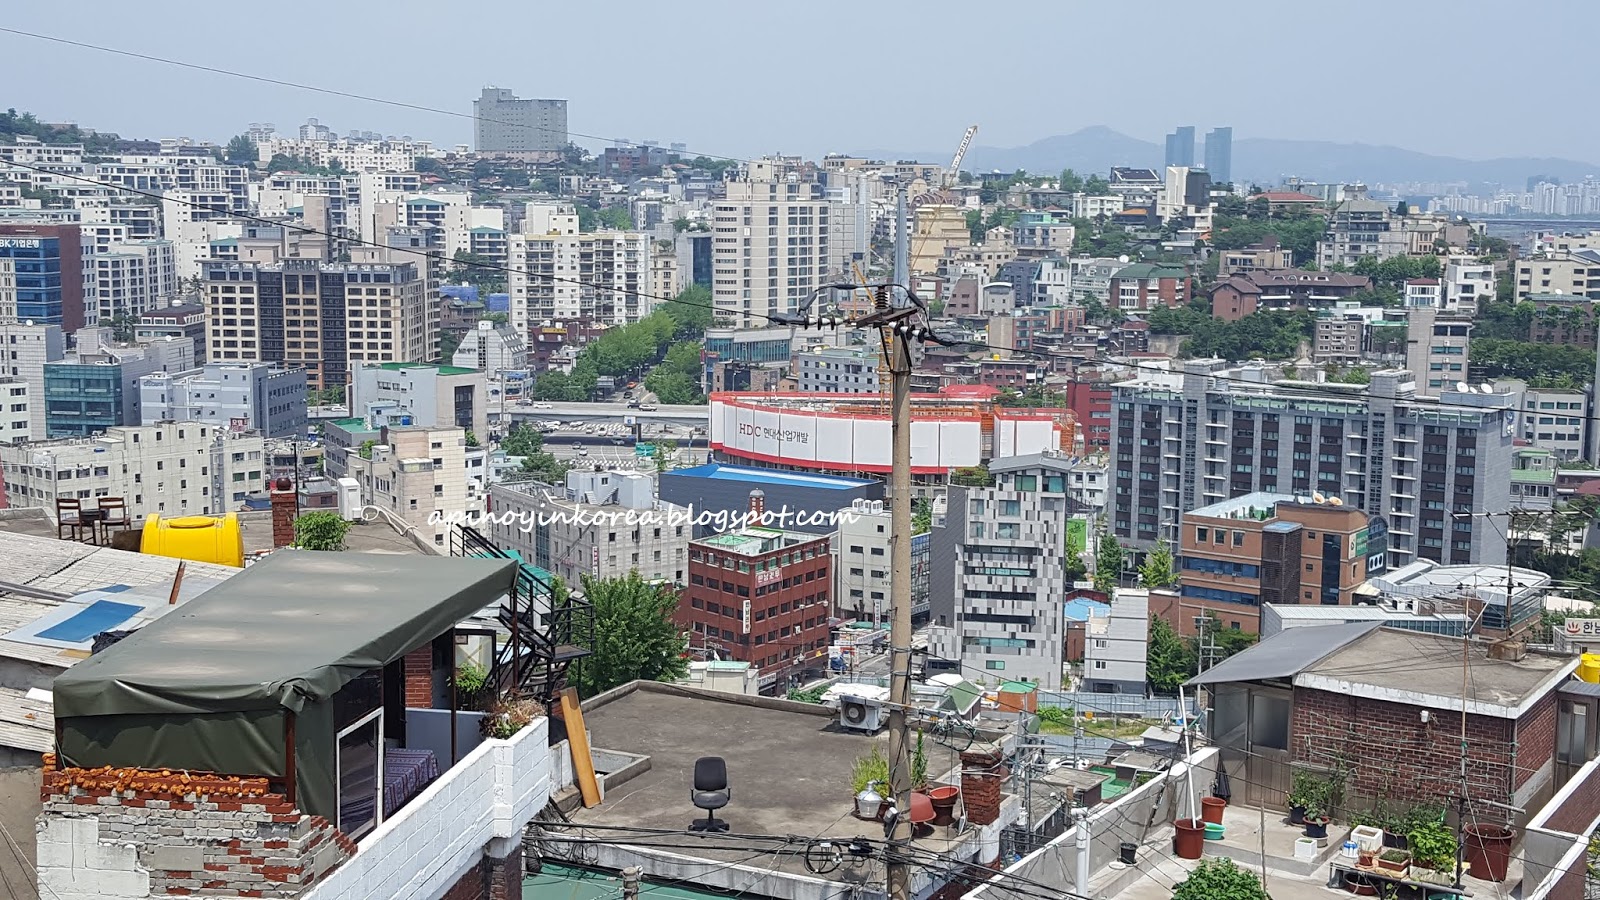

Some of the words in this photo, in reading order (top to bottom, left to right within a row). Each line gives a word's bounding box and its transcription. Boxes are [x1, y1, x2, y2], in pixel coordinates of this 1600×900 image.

[12, 239, 39, 248] 기업은행
[739, 423, 761, 437] HDC
[763, 427, 809, 444] 현대산업개발
